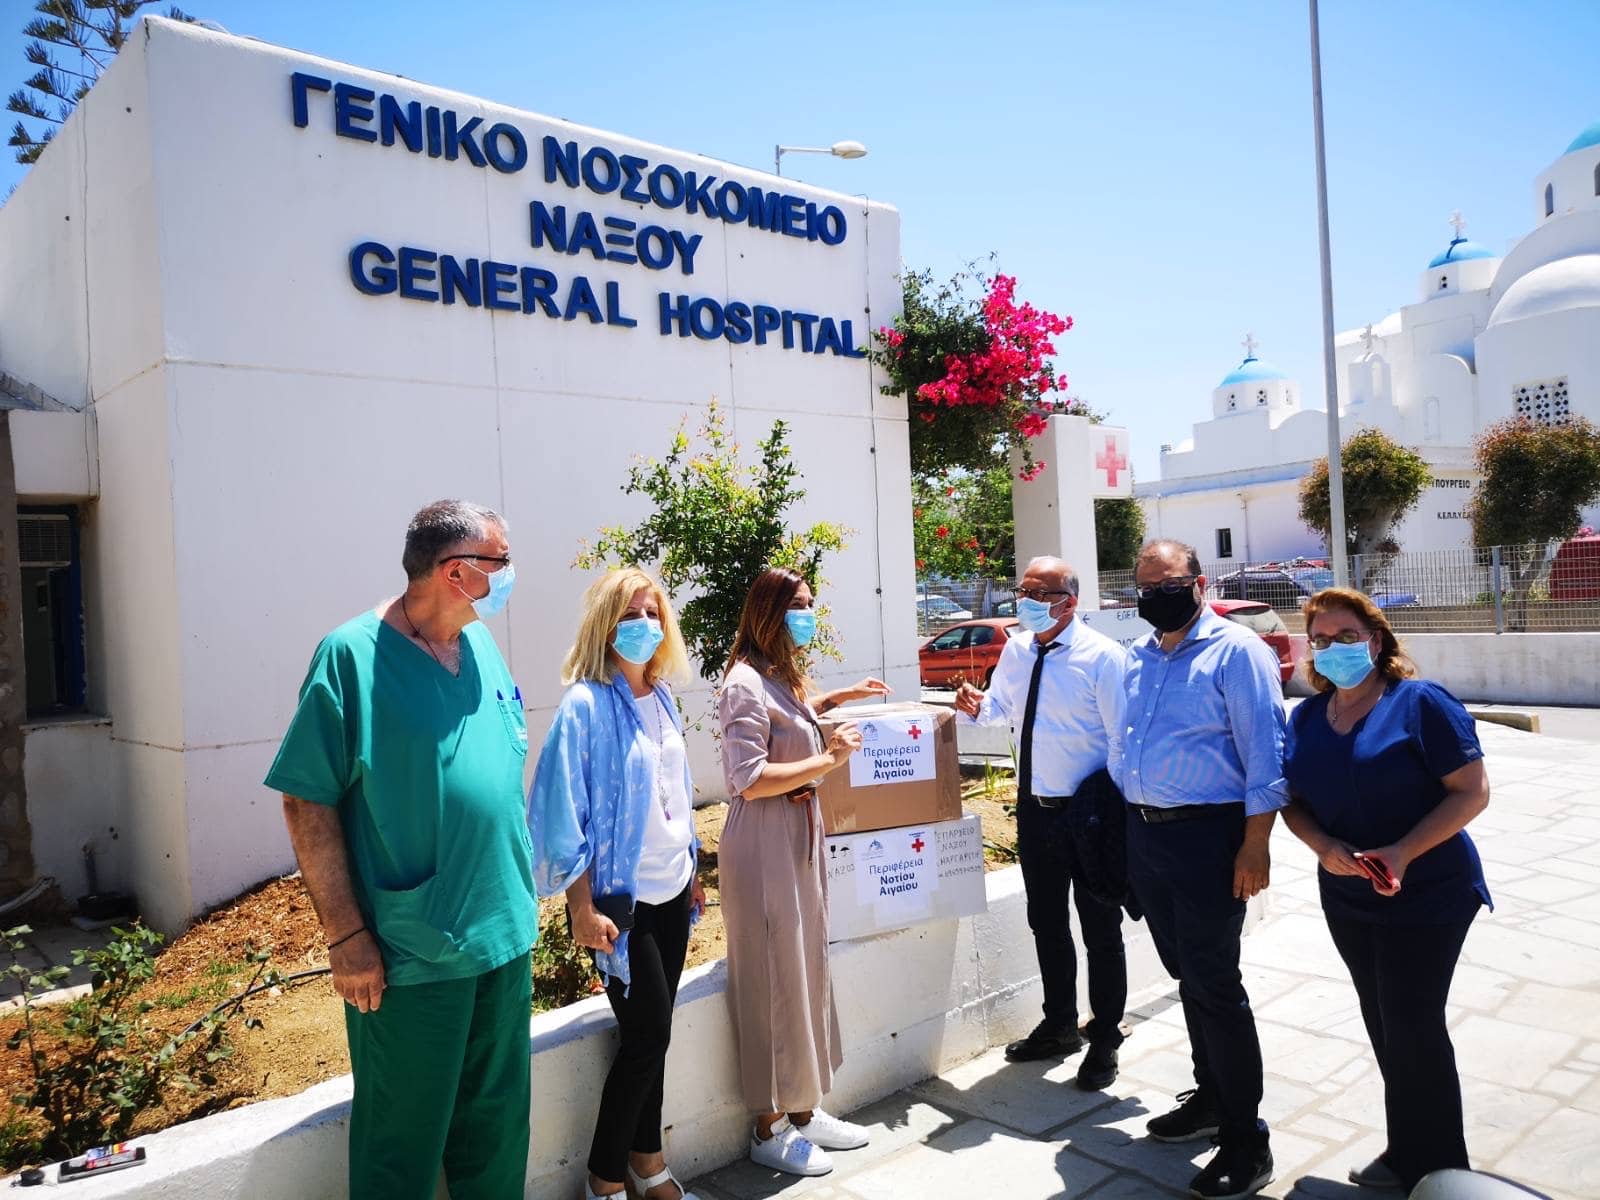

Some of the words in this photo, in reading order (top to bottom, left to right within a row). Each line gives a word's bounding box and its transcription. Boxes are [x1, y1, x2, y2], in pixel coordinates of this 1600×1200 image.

[291, 71, 528, 174] ΓΕΝΙΚΟ
[542, 134, 847, 246] ΝΟΣΟΚΟΜΕΙΟ
[529, 200, 703, 275] ΝΑΞΟΥ
[348, 241, 638, 328] GENERAL
[659, 291, 866, 360] HOSPITAL
[863, 745, 921, 758] Περιφέρεια
[874, 757, 912, 769] Νοτίου
[873, 768, 914, 780] Αιγαίου
[869, 858, 923, 875] Περιφέρεια
[880, 871, 915, 885] Νοτίου
[879, 882, 918, 896] Αιγαίου
